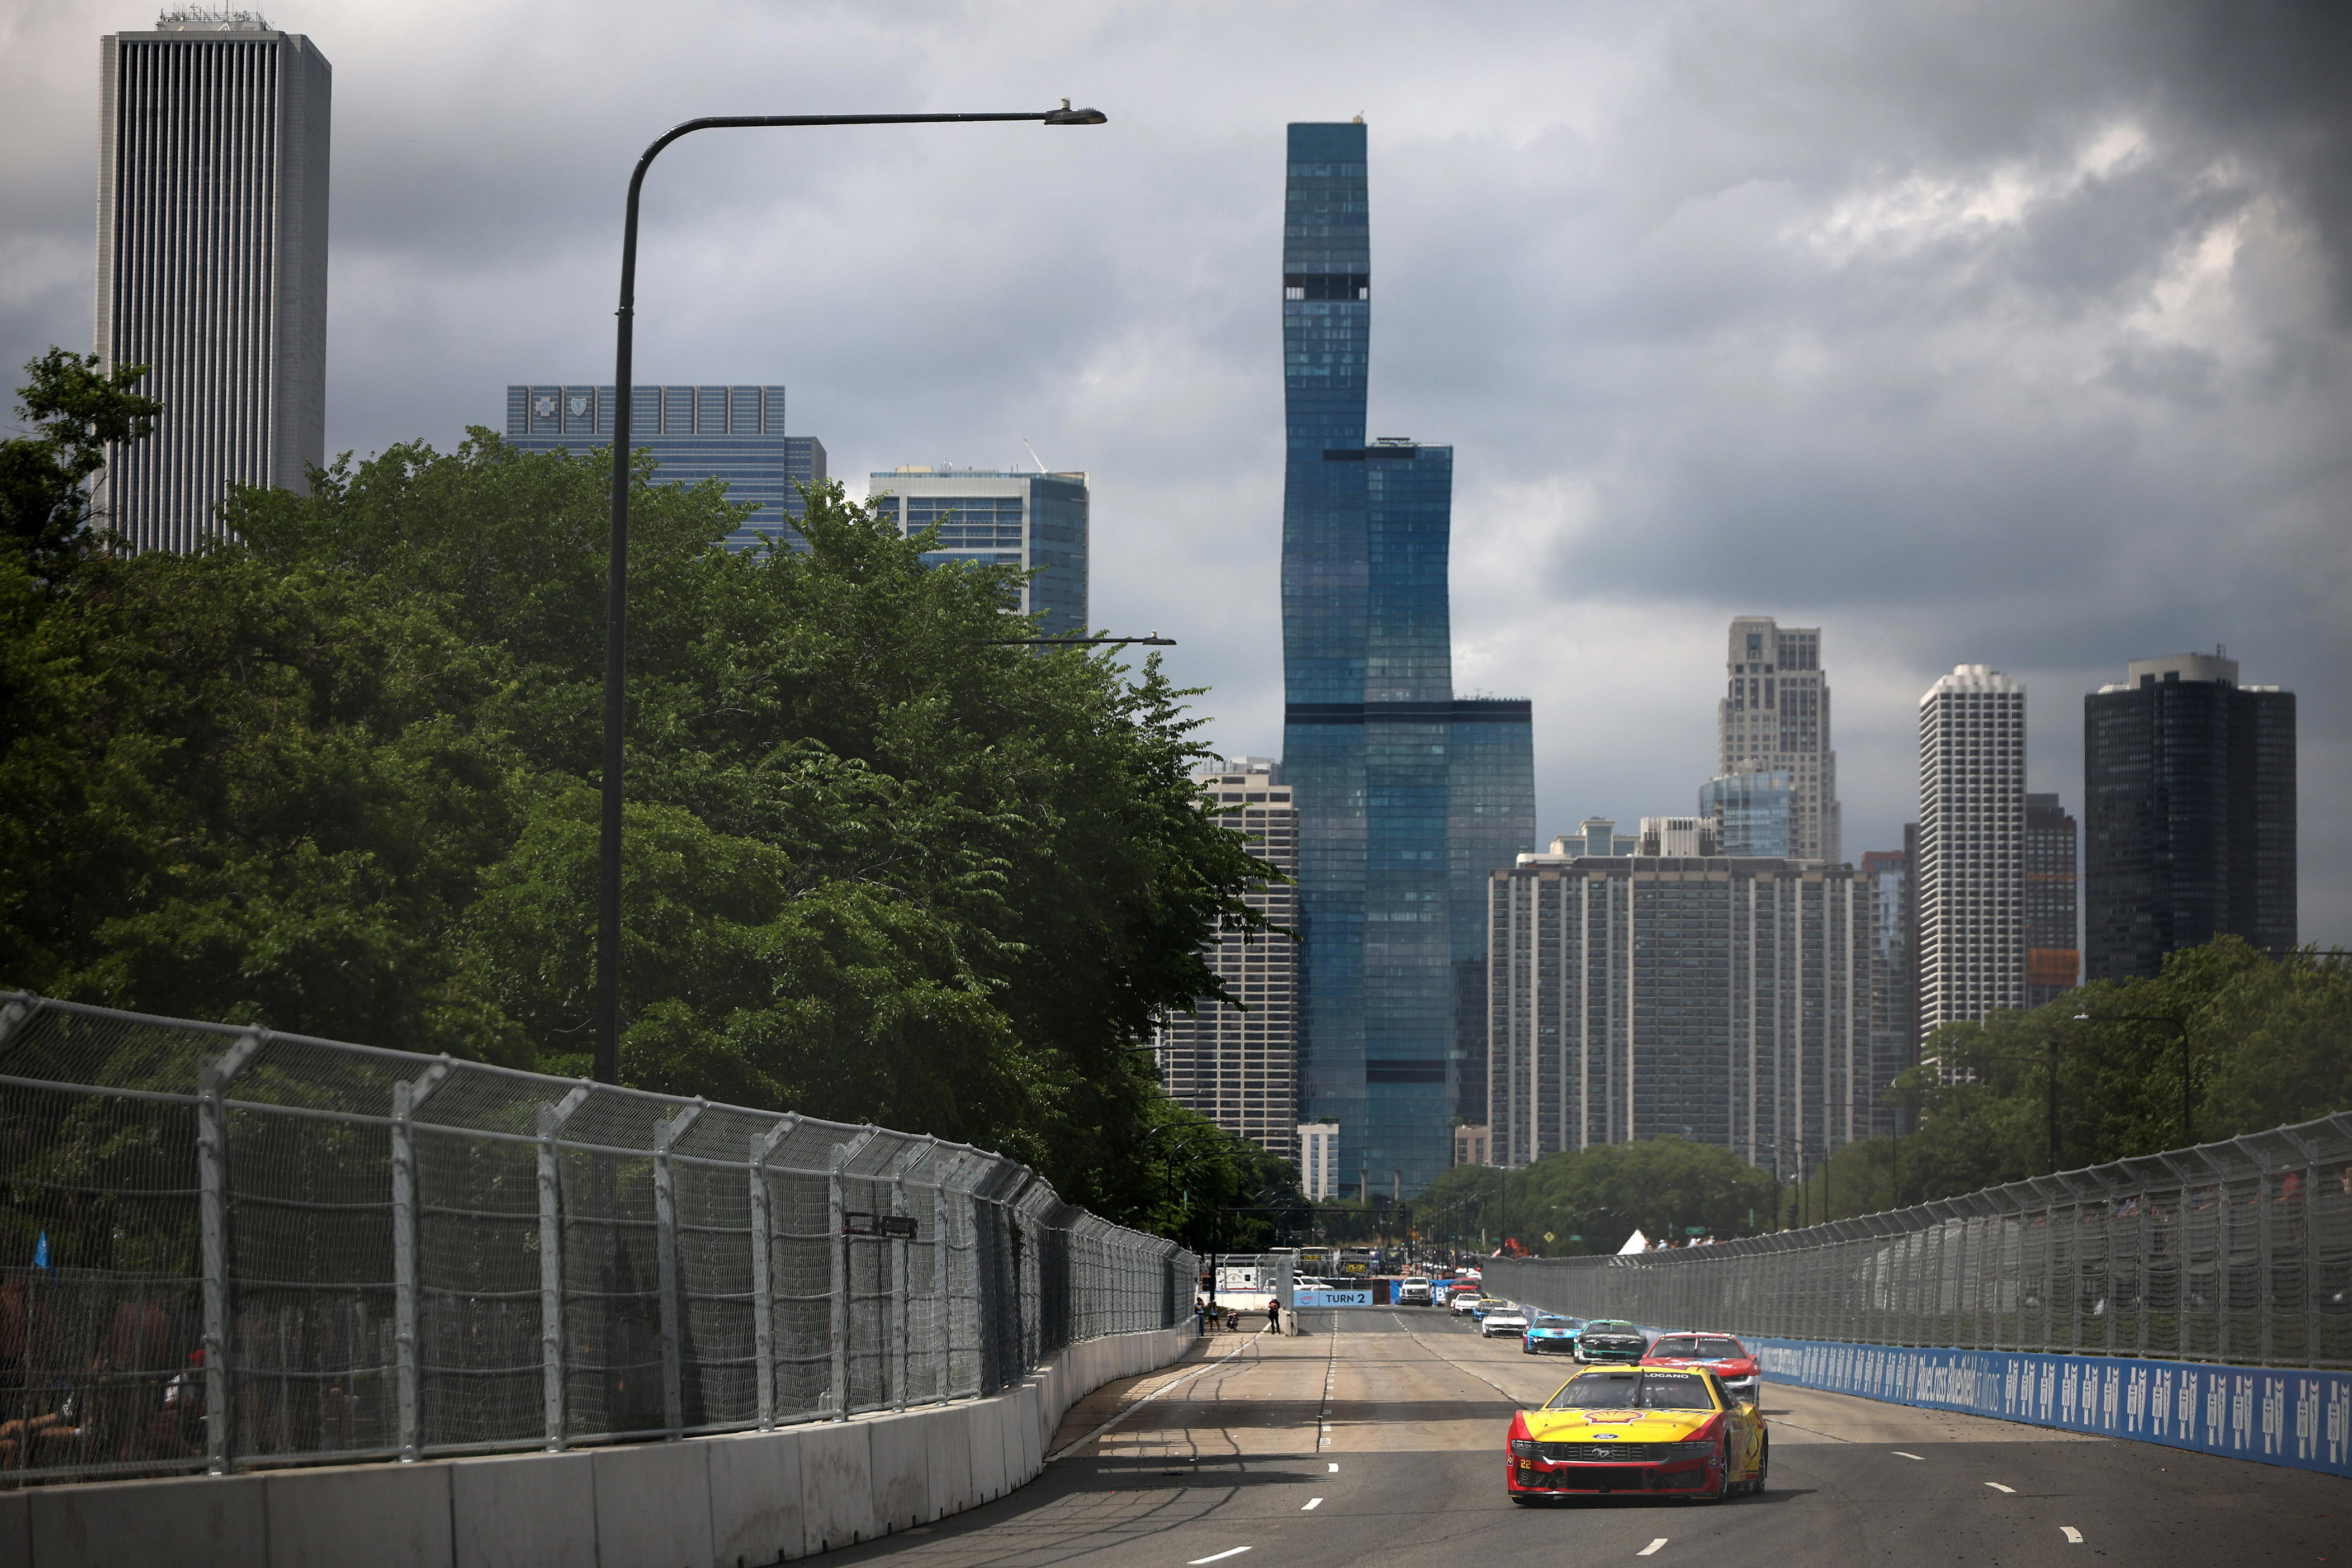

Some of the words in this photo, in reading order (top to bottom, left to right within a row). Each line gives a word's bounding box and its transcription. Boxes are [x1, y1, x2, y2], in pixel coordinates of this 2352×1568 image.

[1357, 1294, 1365, 1303] 2
[1916, 1354, 1948, 1402] BlueCross
[1946, 1355, 1977, 1406] BlueShield
[1521, 1458, 1531, 1470] 22
